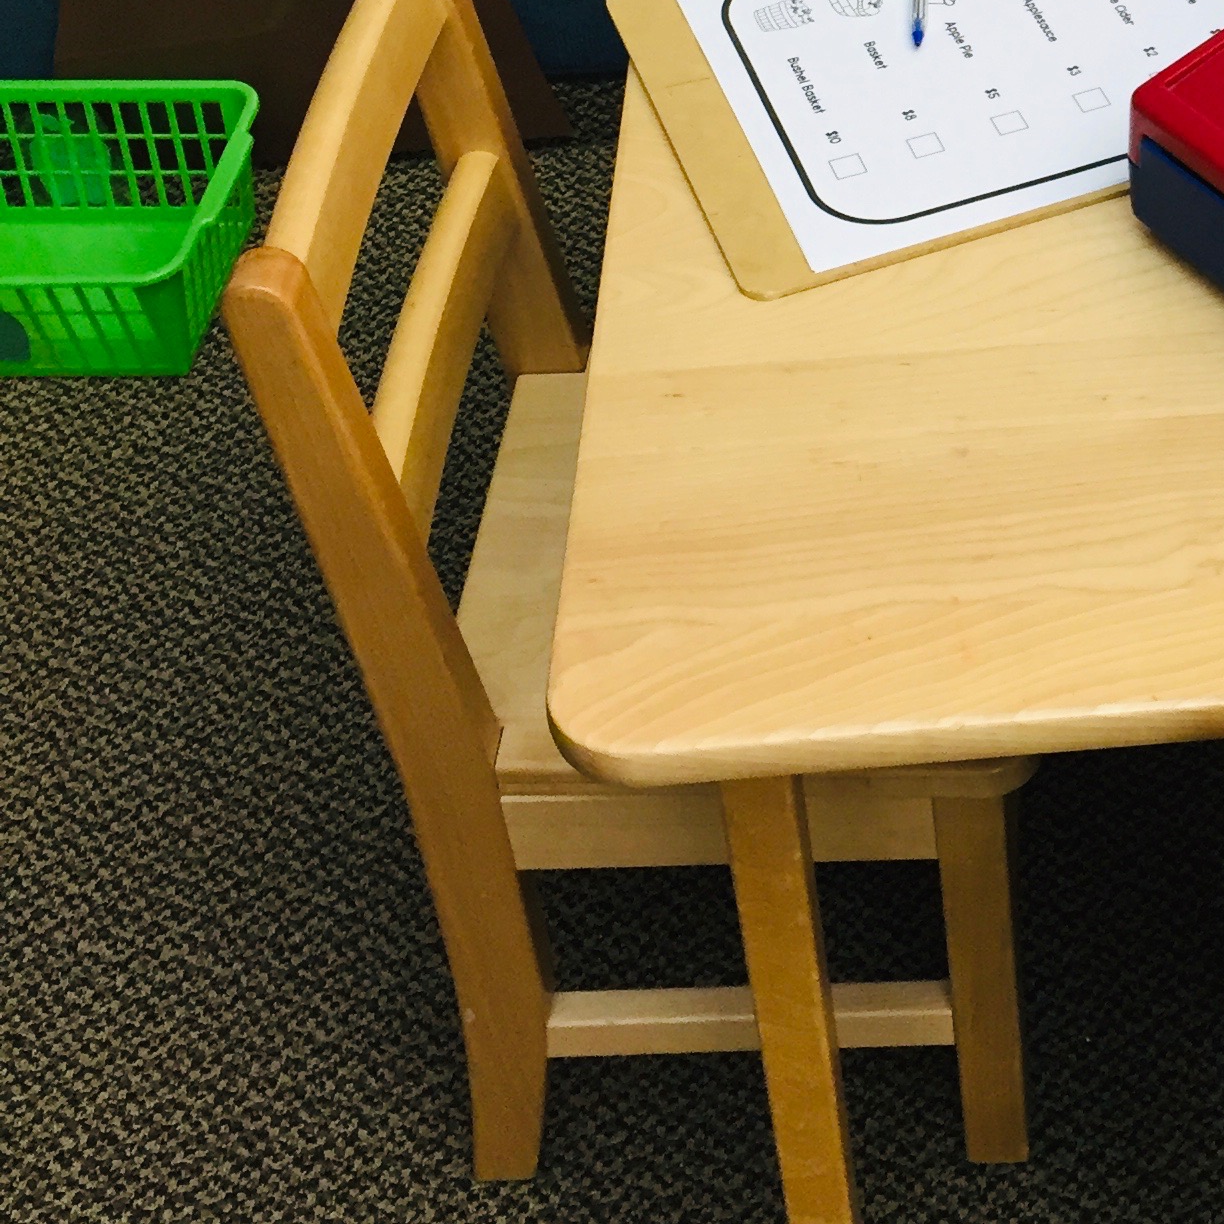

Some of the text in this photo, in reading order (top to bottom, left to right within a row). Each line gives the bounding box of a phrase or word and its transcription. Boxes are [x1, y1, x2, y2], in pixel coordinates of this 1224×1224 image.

[863, 40, 888, 69] Basket
[944, 21, 974, 59] Apple Pie
[787, 56, 827, 114] Bushel Basket
[984, 88, 1001, 100] $5
[825, 130, 842, 144] $10
